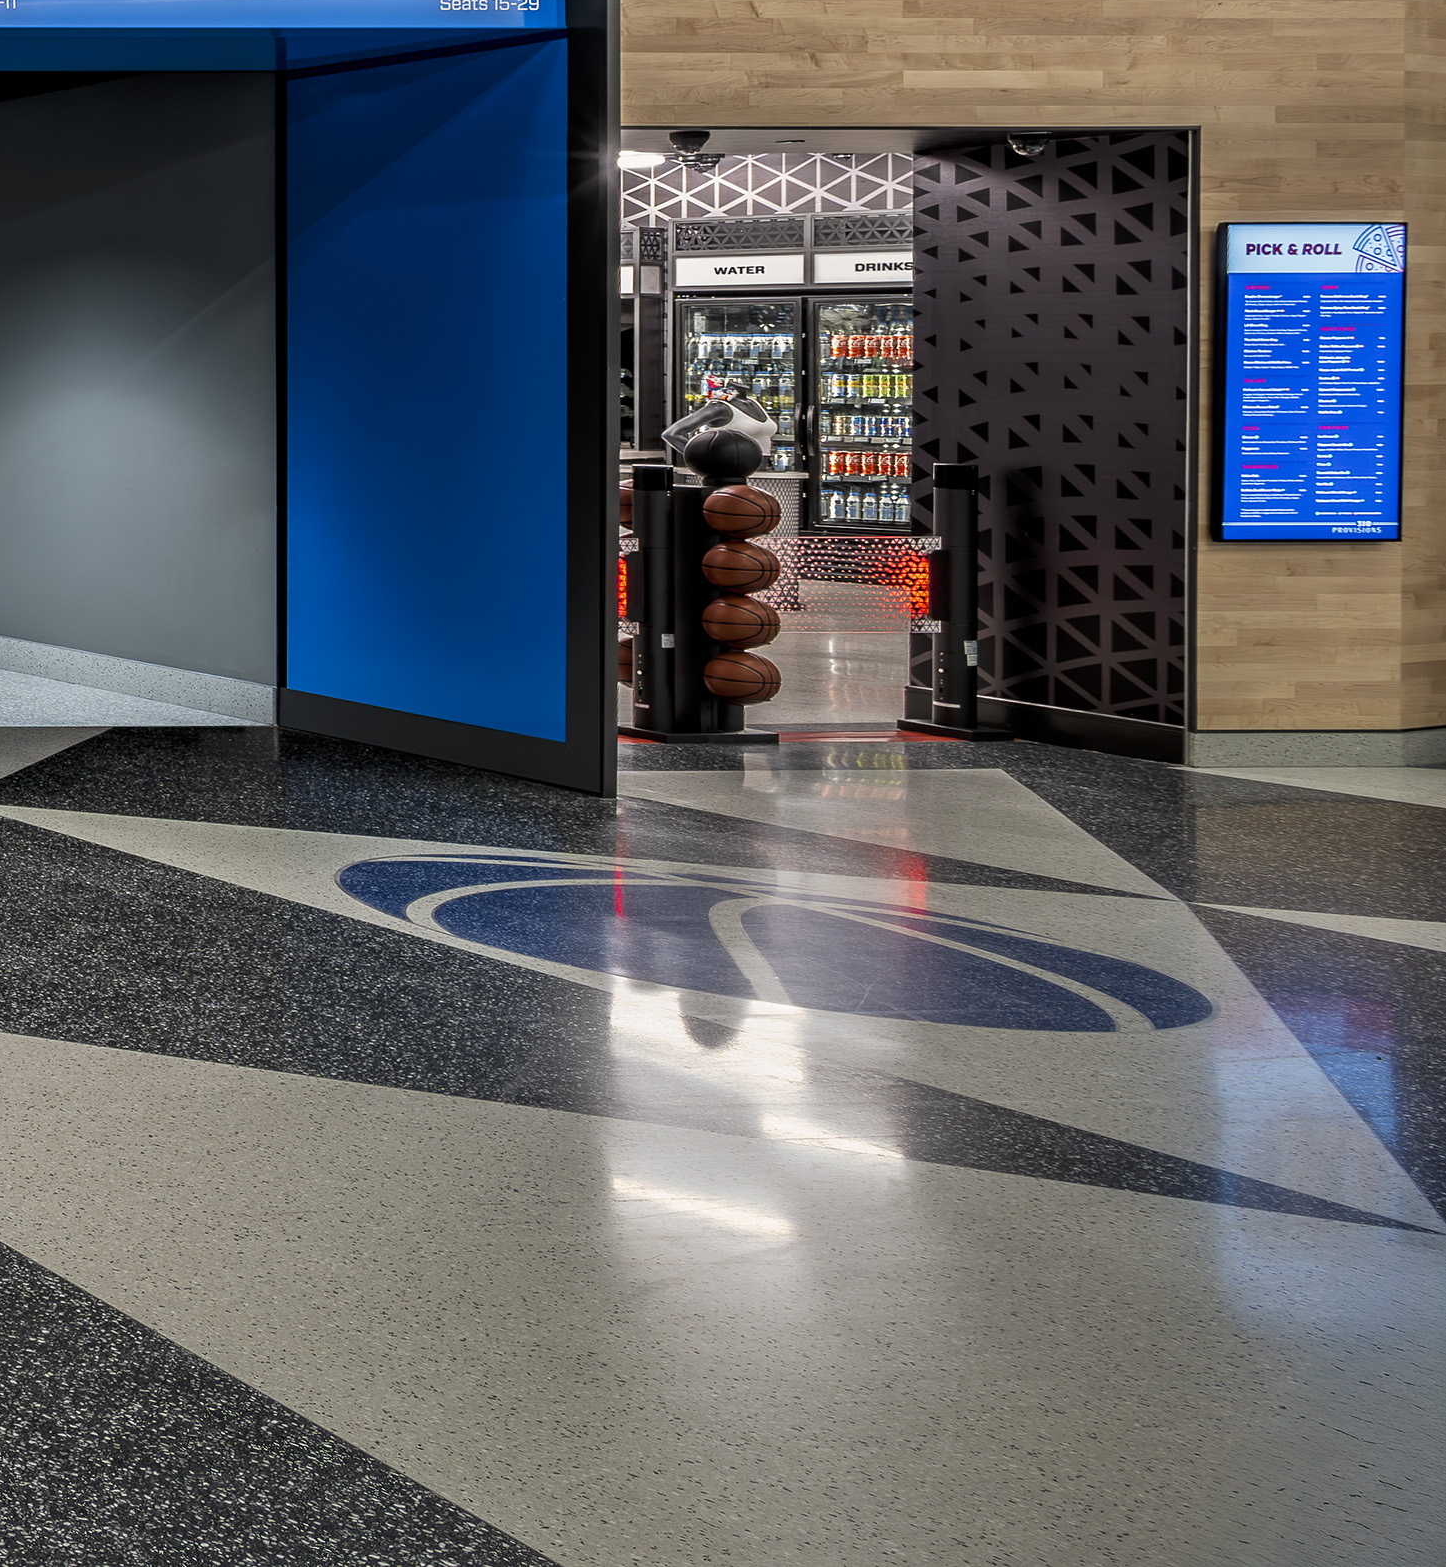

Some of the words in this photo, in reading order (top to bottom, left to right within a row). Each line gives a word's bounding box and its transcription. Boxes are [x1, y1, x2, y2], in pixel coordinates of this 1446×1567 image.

[1246, 244, 1282, 255] PICK
[1288, 244, 1298, 255] &
[1302, 244, 1341, 255] ROLL
[714, 265, 764, 275] WATER
